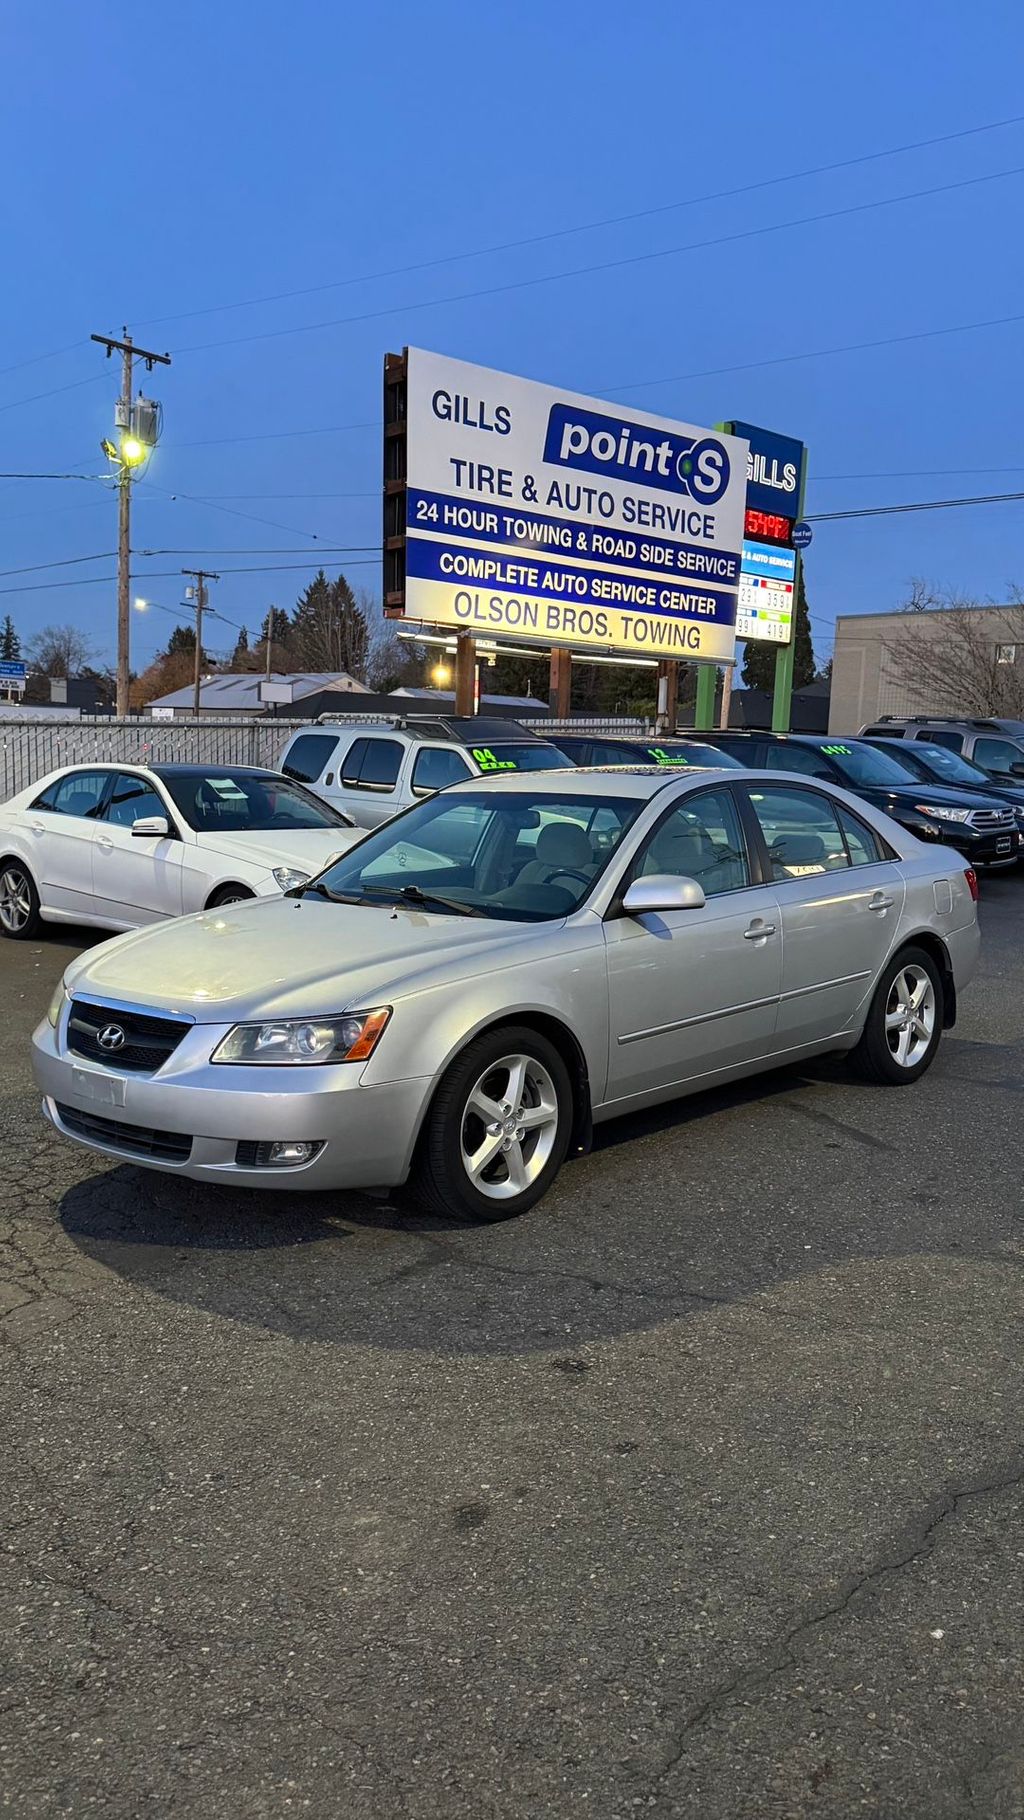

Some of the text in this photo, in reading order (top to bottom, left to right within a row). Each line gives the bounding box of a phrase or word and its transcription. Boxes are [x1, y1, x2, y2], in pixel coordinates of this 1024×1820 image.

[432, 390, 511, 435] GILLS
[560, 422, 723, 493] point S
[450, 458, 715, 539] TIRE & AUTO SERVICE
[416, 500, 736, 577] 24 HOUR TOWING & ROAD SIDE SERVICE
[440, 553, 716, 615] COMPLETE AUTO SERVICE CENTER
[454, 591, 701, 649] OLSON BROS. TOWING
[472, 748, 497, 762] 04
[648, 748, 670, 759] 12
